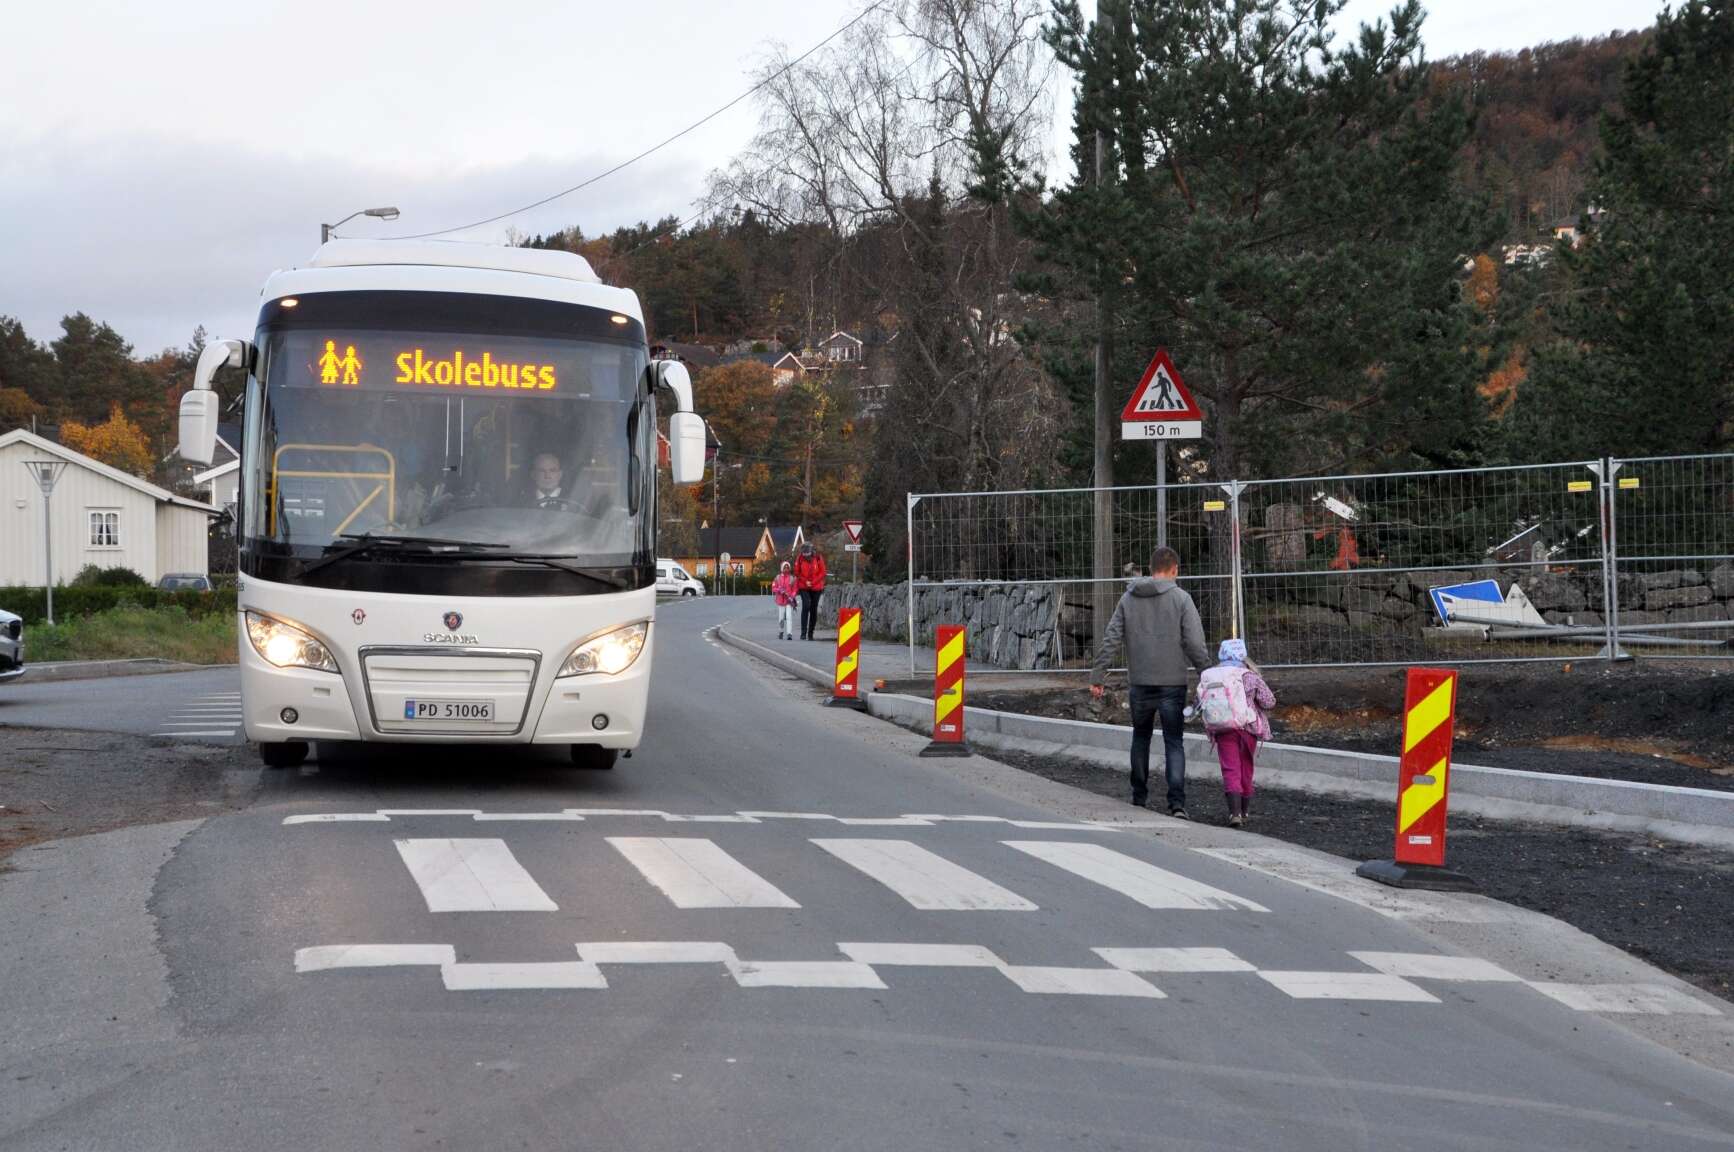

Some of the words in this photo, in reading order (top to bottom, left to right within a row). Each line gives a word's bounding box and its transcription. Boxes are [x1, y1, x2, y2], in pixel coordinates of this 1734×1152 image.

[395, 349, 556, 390] Skolebuss
[1144, 424, 1165, 436] 150
[1169, 426, 1181, 436] m
[423, 632, 479, 645] SCANIA
[418, 703, 438, 717] PD
[445, 704, 489, 718] 51006
